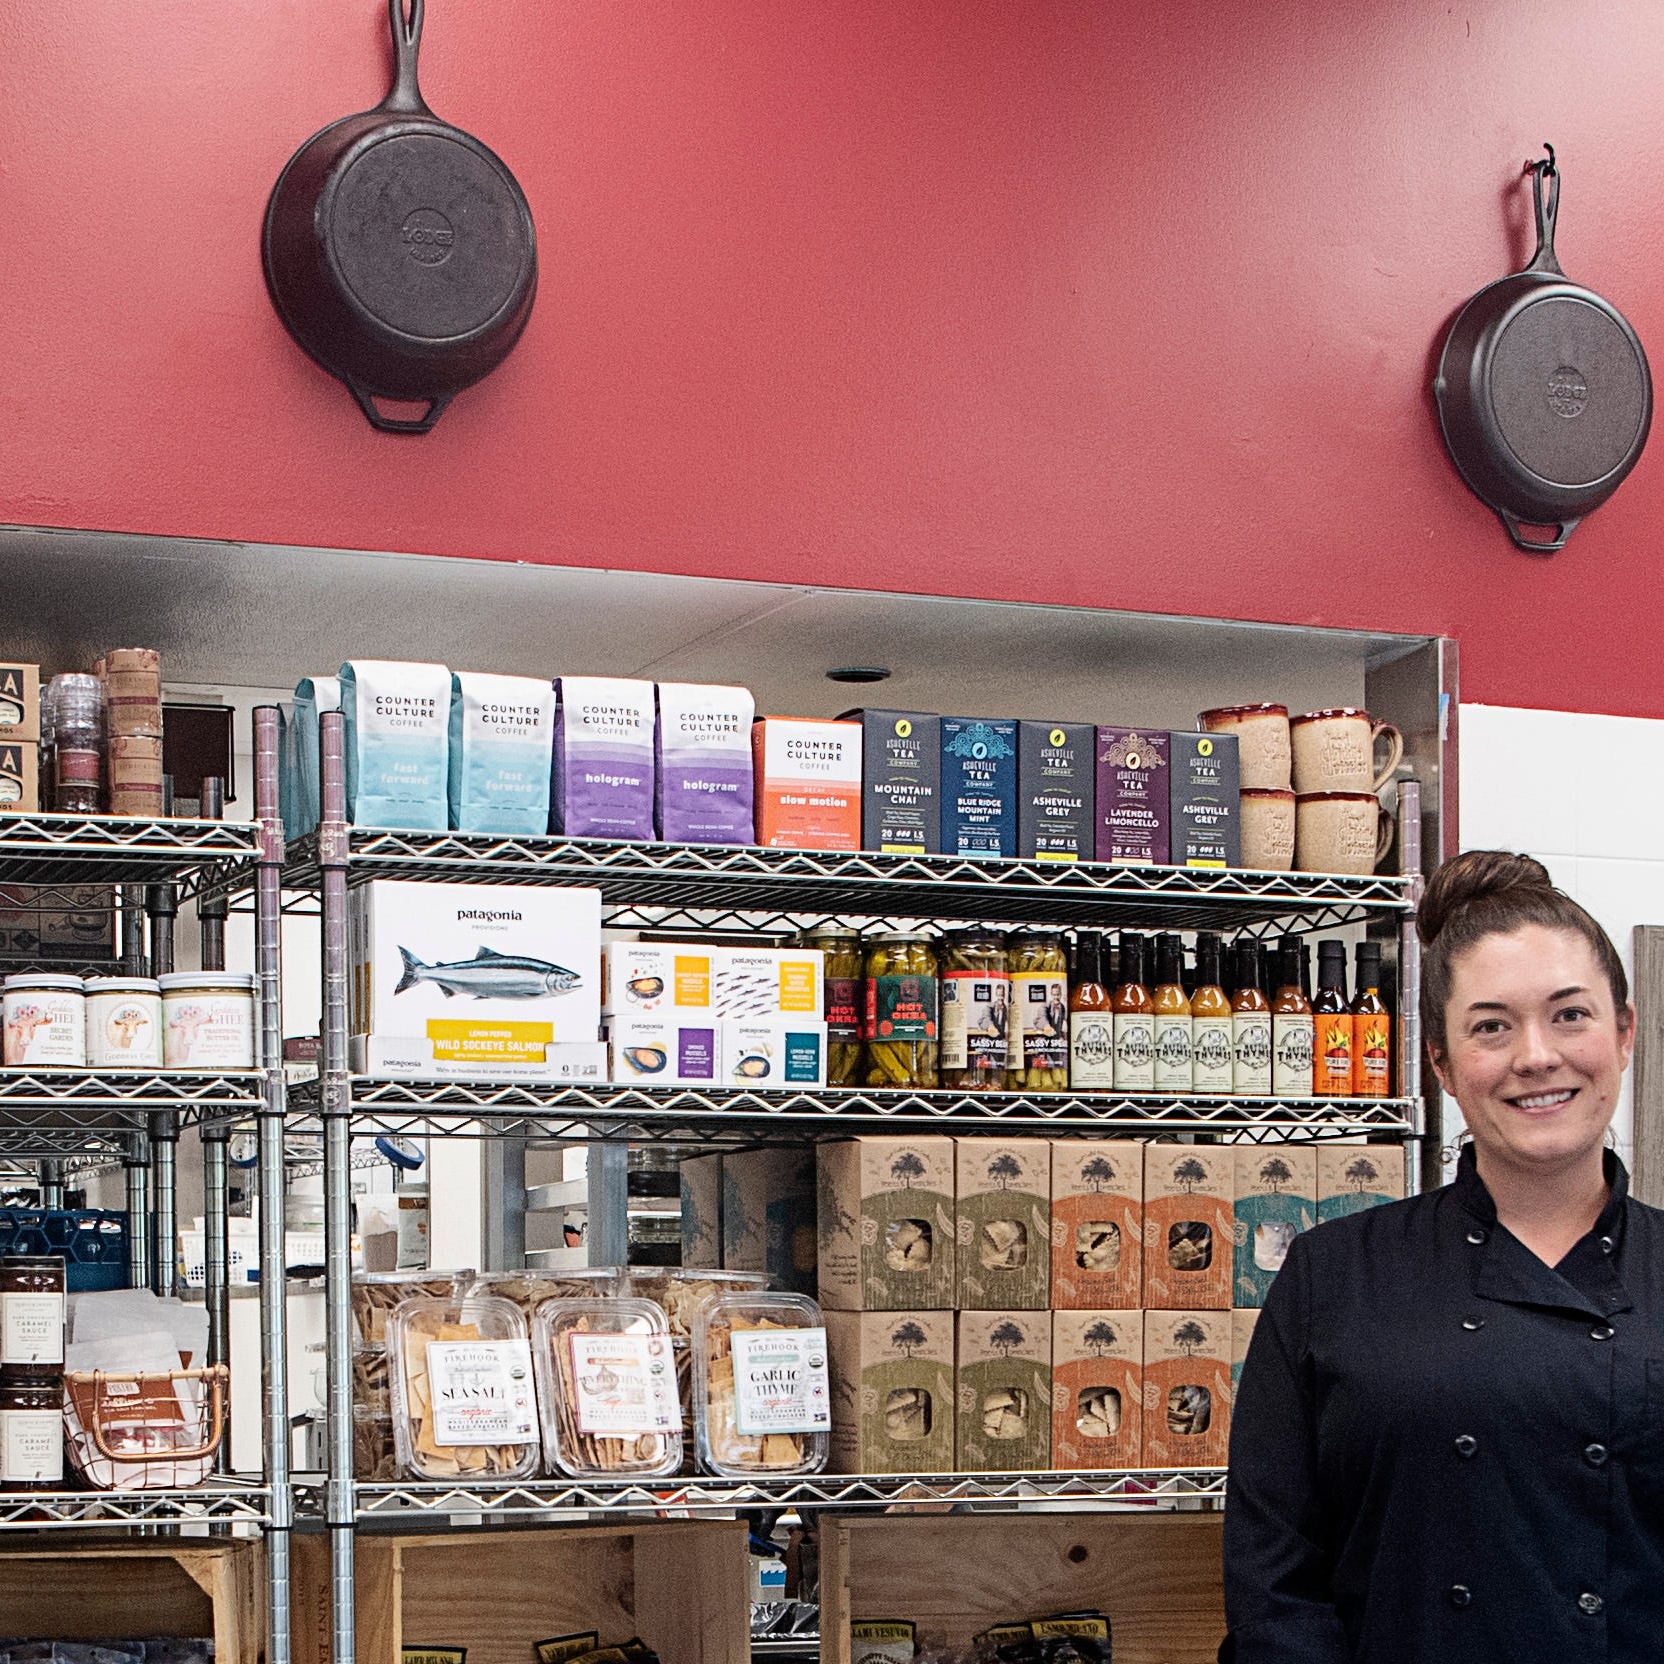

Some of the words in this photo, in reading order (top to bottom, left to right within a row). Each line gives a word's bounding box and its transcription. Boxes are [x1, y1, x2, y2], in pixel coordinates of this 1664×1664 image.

[376, 696, 435, 706] COUNTER
[376, 706, 435, 718] CULTURE
[481, 704, 541, 716] COUNTER
[583, 706, 640, 717] COUNTER
[481, 714, 539, 726] CULTURE
[583, 716, 640, 728] CULTURE
[679, 713, 738, 722] COUNTER
[681, 723, 738, 733] CULTURE
[787, 740, 843, 751] COUNTER
[787, 750, 842, 762] CULTURE
[799, 762, 831, 771] COFFEE
[1047, 758, 1068, 768] TEA
[585, 773, 640, 788] hologram
[683, 780, 738, 793] hologram
[875, 784, 932, 796] MOUNTAIN
[780, 795, 807, 806] slow
[809, 796, 847, 808] motion
[891, 795, 917, 805] CHAI
[957, 798, 978, 806] BLUE
[979, 798, 1001, 808] RIDGE
[1033, 796, 1082, 807] ASHEVILLE
[957, 806, 1002, 815] MOUNTAIN
[1045, 806, 1070, 817] GREY
[1110, 808, 1153, 819] LAVENDER
[1183, 805, 1229, 816] ASHEVILLE
[969, 815, 991, 823] MINT
[1105, 817, 1159, 828] LIMONCELLO
[1195, 815, 1218, 825] GREY
[457, 908, 523, 922] patagonia
[436, 1039, 460, 1051] WILD
[463, 1040, 504, 1052] SOCKEYE
[507, 1041, 545, 1052] SALMON
